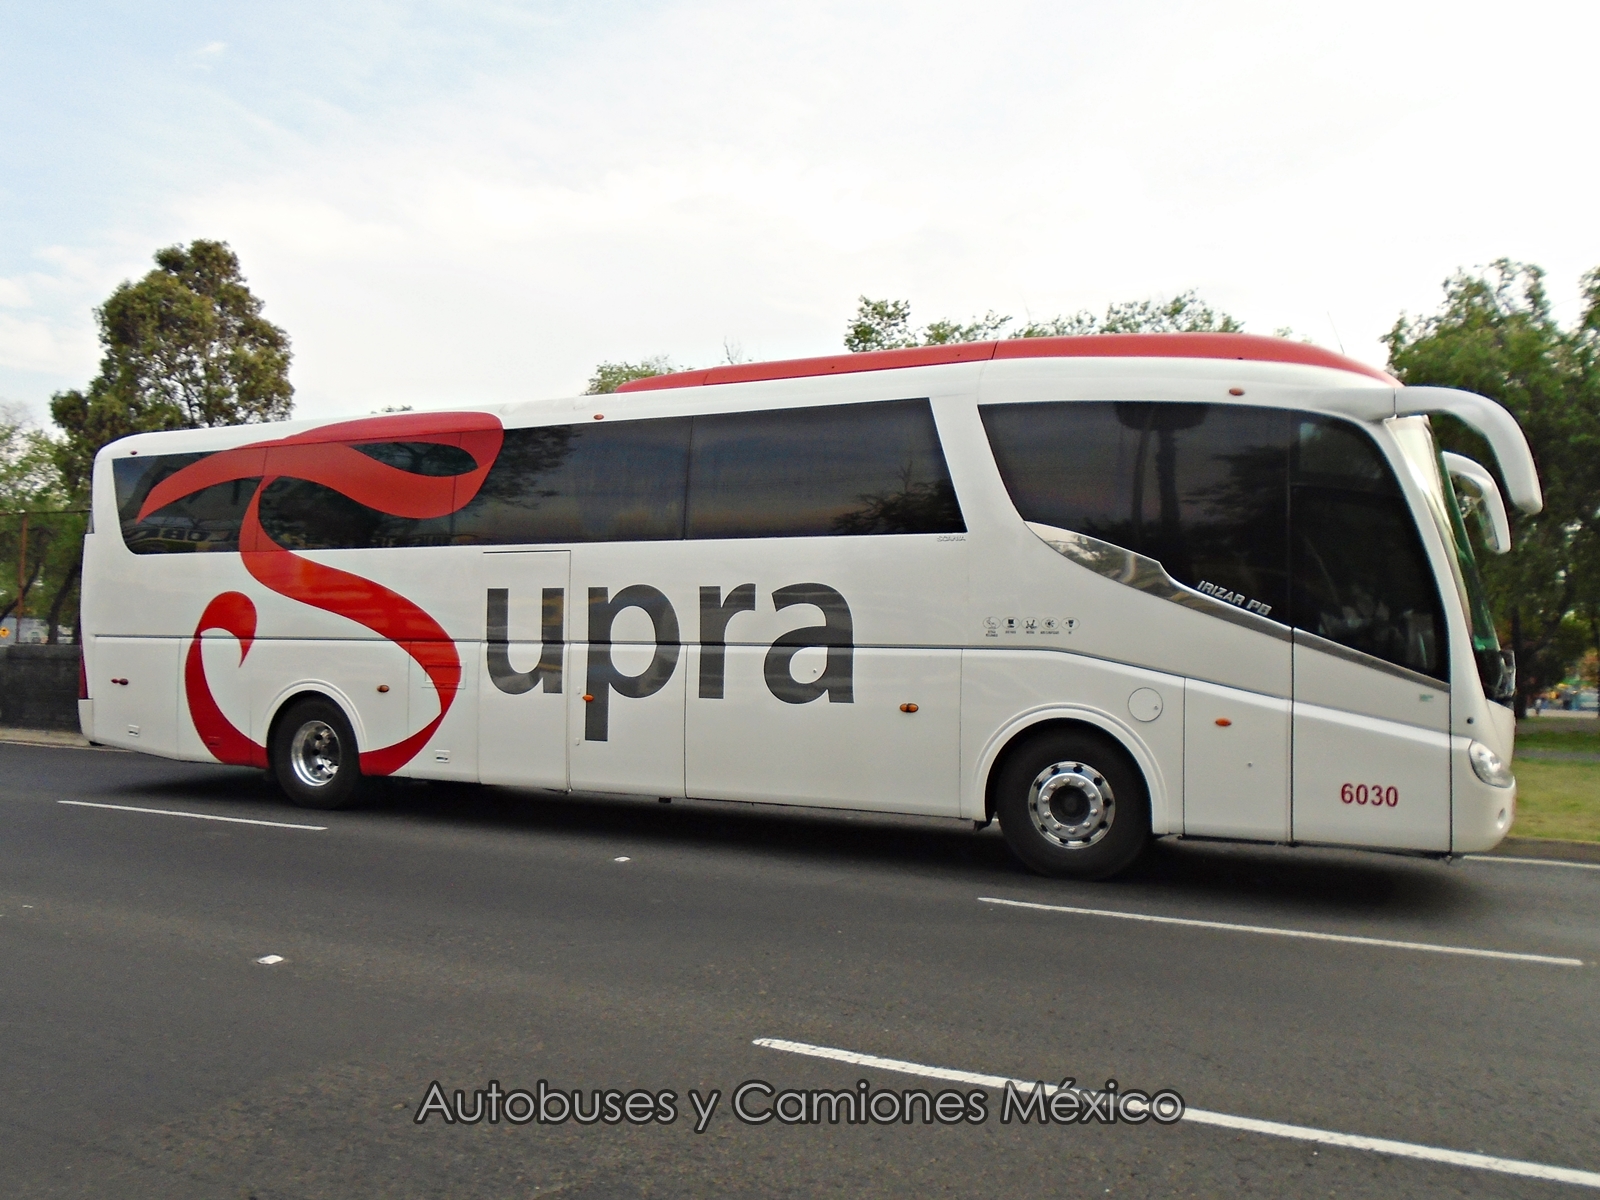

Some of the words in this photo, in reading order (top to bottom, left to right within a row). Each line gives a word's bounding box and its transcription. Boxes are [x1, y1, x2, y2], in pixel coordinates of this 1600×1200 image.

[136, 411, 855, 777] Supra
[1197, 580, 1246, 606] IRIZAR
[1341, 783, 1398, 807] 6030
